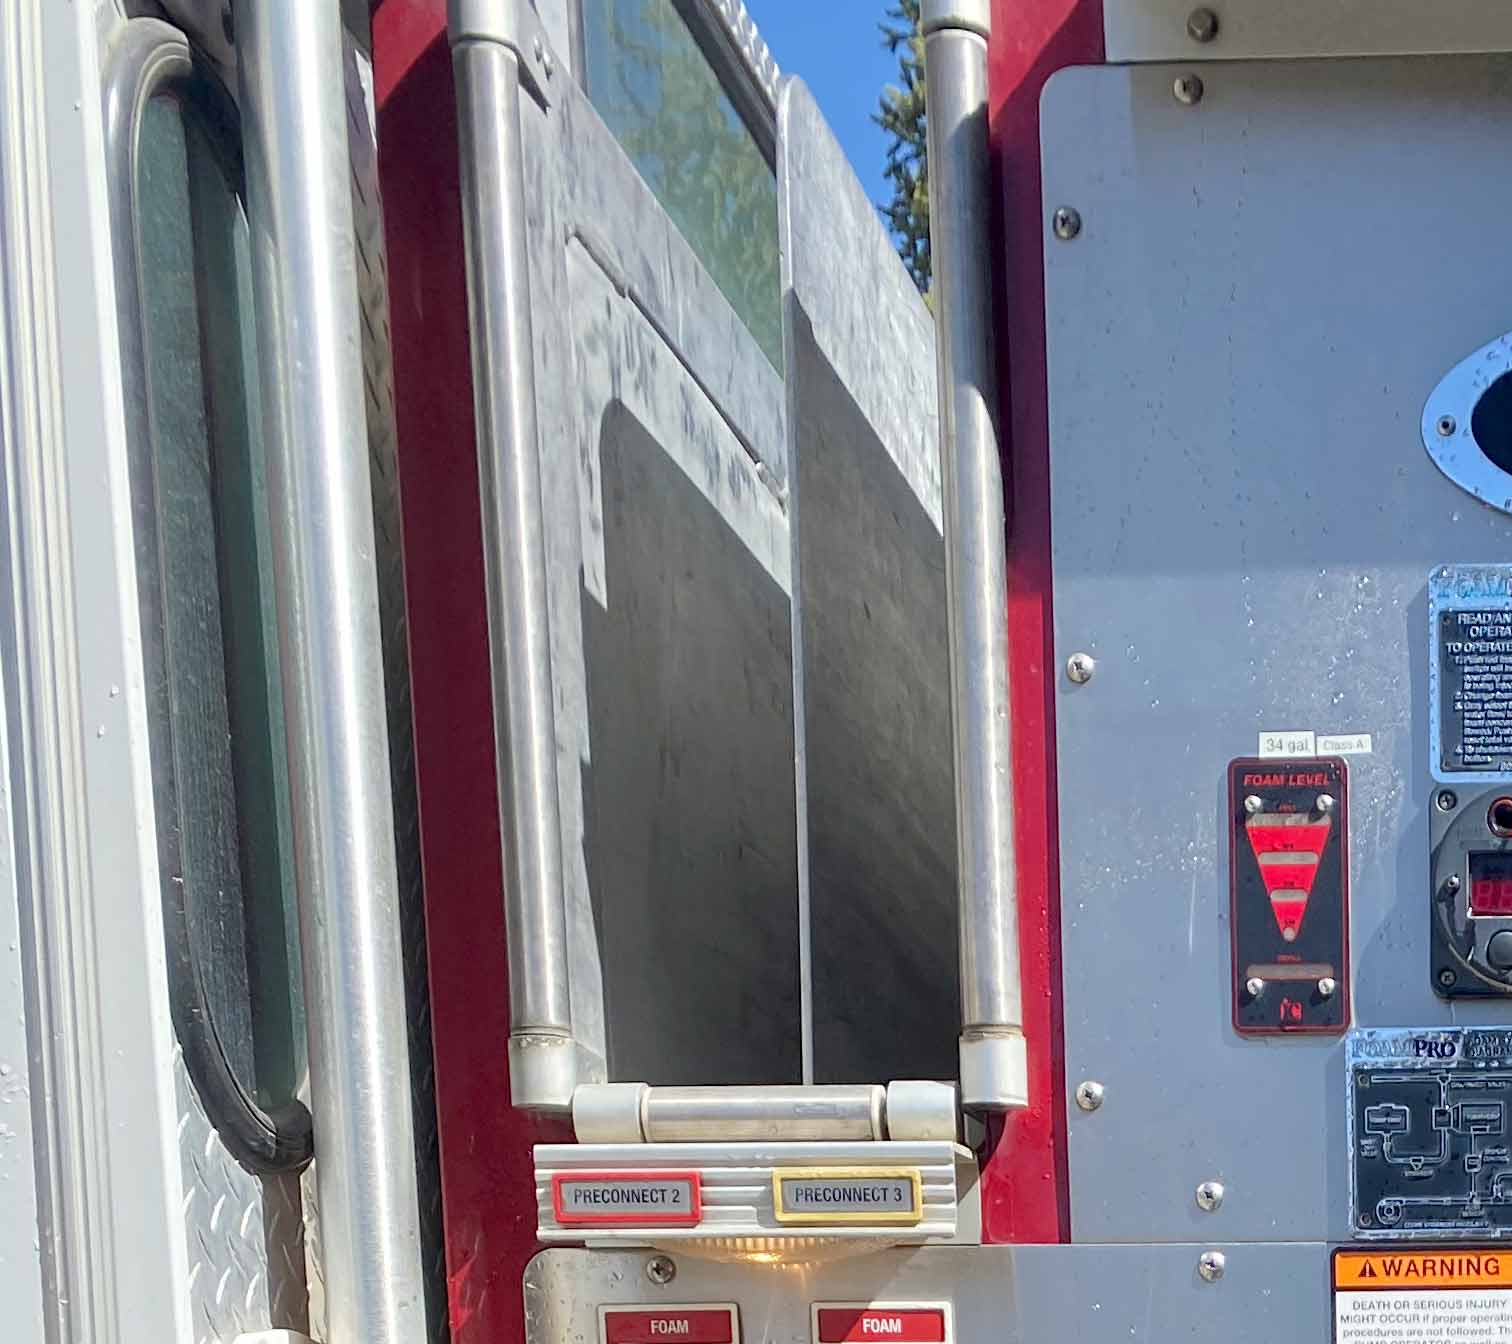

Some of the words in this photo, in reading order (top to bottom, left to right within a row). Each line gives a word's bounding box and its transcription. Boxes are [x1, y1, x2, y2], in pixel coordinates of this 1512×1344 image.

[1457, 612, 1492, 624] READ
[1264, 738, 1283, 752] 34
[1243, 774, 1283, 787] FOAM
[1288, 774, 1330, 787] LEVEL
[574, 1187, 667, 1204] PRECONNECT
[671, 1187, 681, 1204] 2
[794, 1186, 887, 1203] PRECONNECT
[890, 1186, 903, 1202] 3
[1382, 1257, 1501, 1278] WARNING
[1352, 1300, 1391, 1310] DEATH
[1393, 1300, 1410, 1310] OR
[1413, 1300, 1463, 1310] SERIOUS
[1465, 1299, 1508, 1309] INJURY
[650, 1319, 689, 1334] FOAM
[862, 1318, 901, 1333] FOAM
